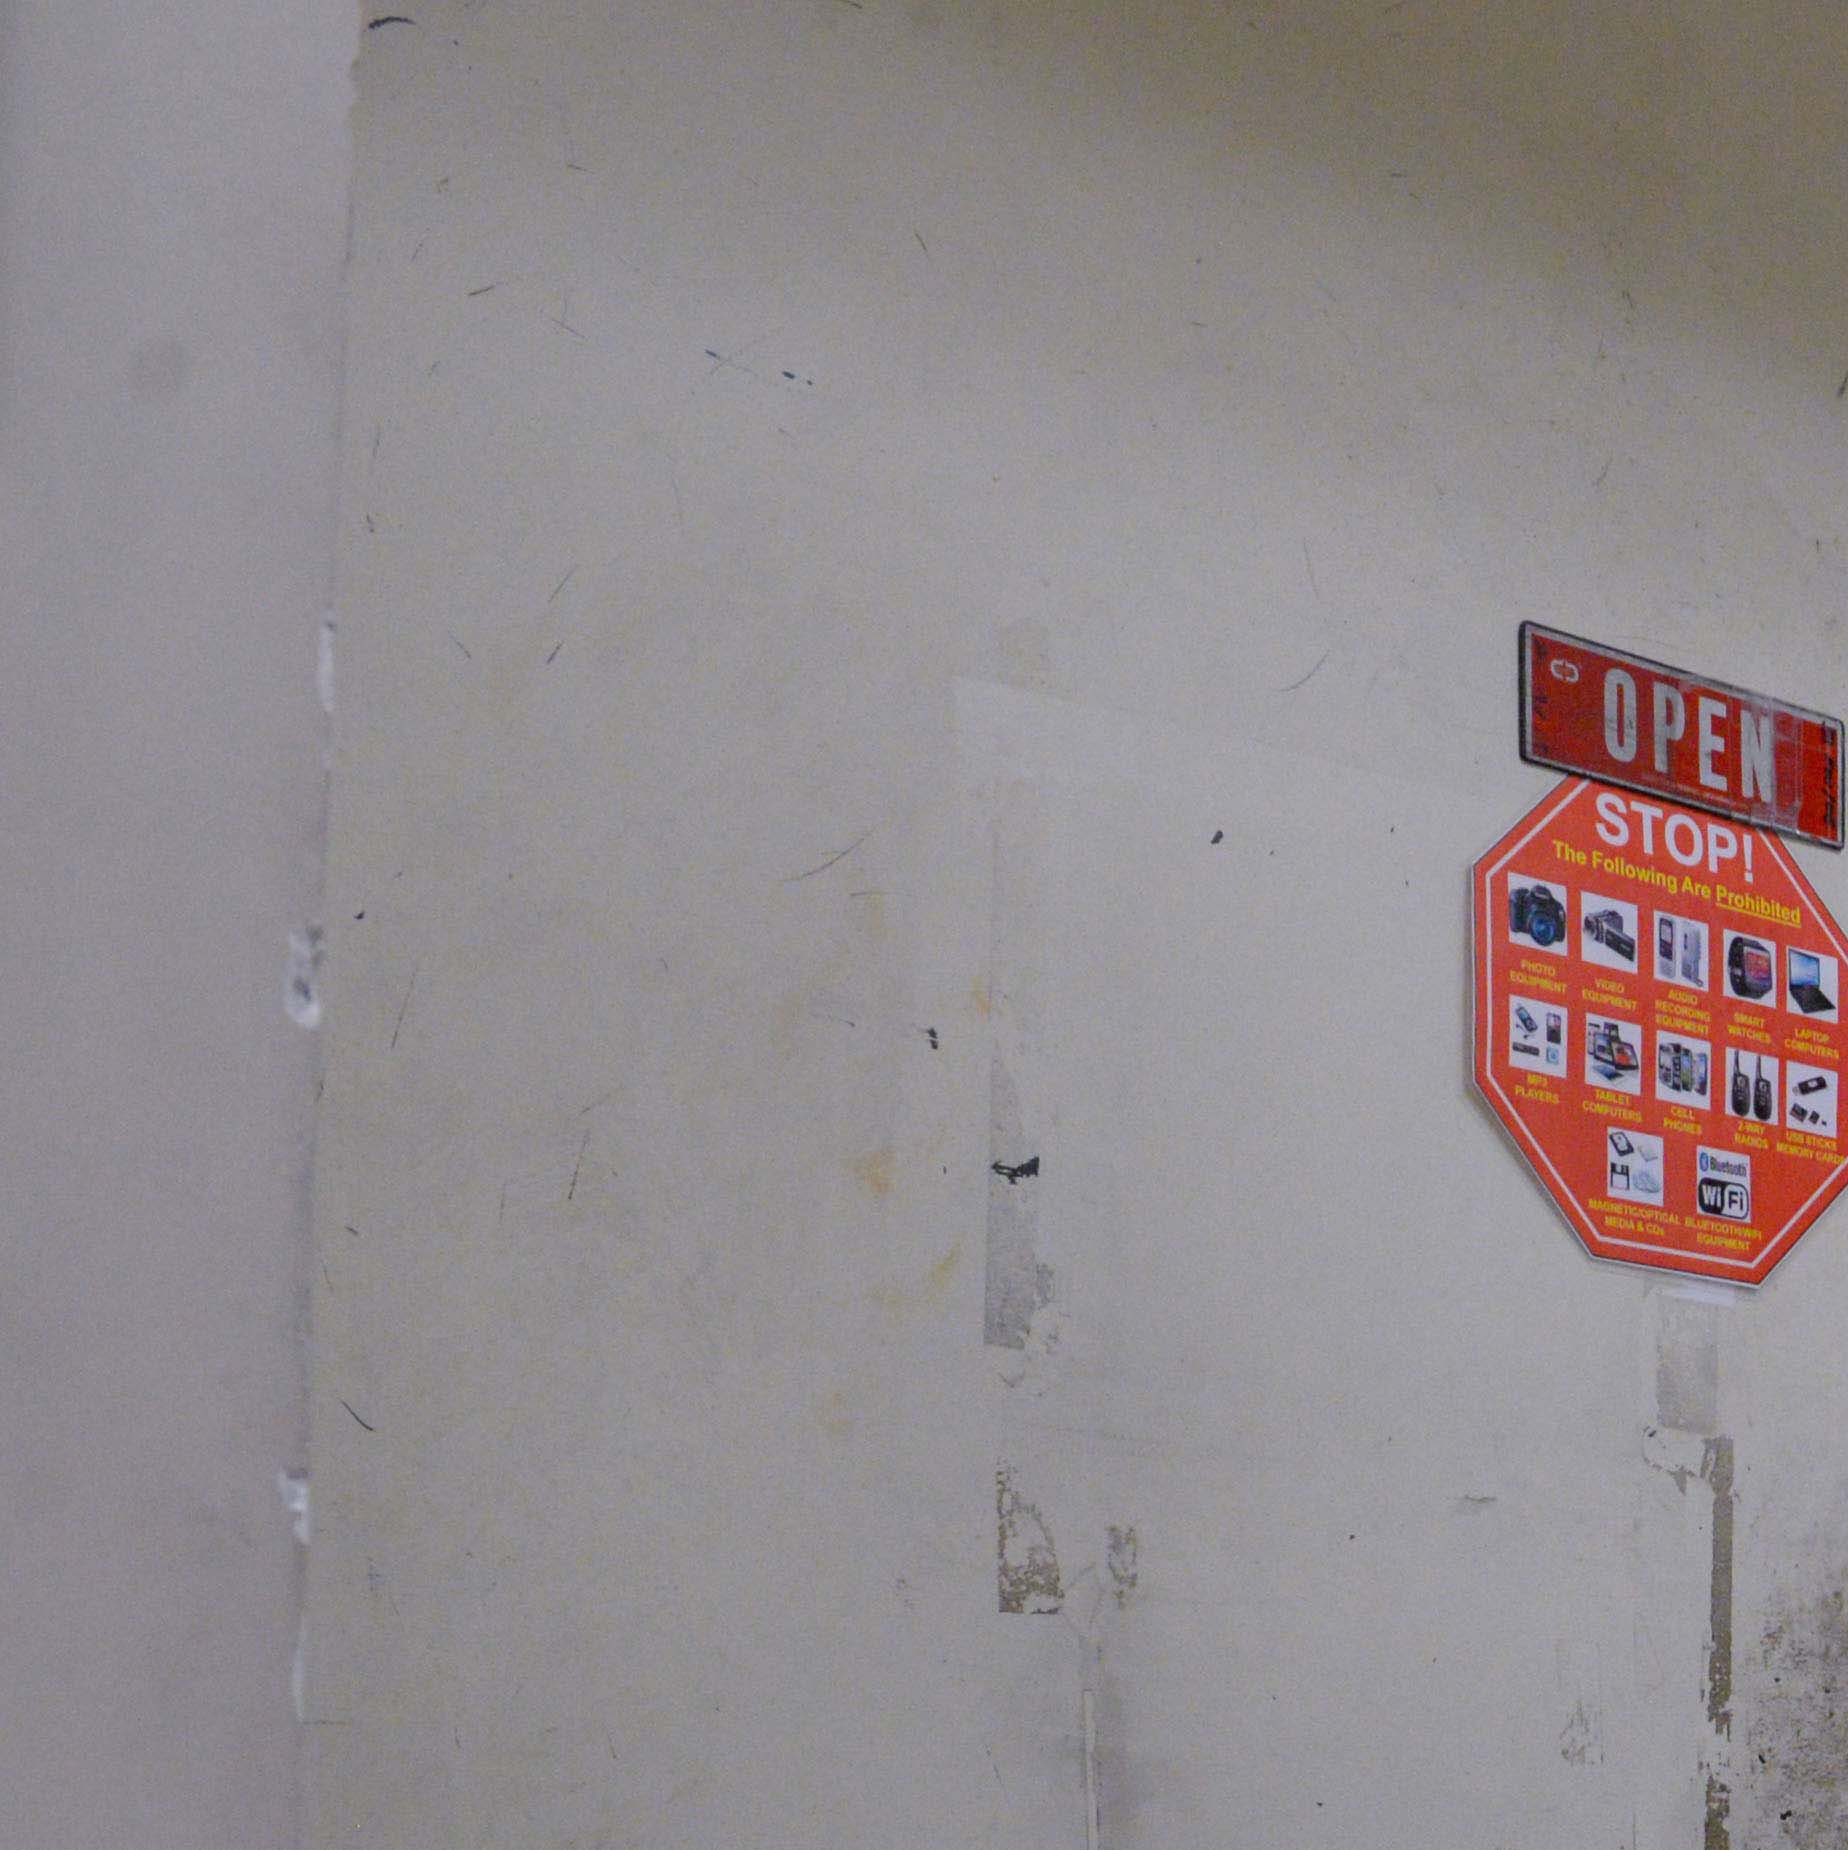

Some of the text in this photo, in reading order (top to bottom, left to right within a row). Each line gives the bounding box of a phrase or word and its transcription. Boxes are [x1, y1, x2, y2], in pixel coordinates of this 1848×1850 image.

[1603, 668, 1772, 803] OPEN
[1596, 792, 1755, 884] STOP!
[1553, 839, 1801, 928] The Following Are Prohibited
[1520, 959, 1556, 978] PHOTO
[1509, 970, 1568, 994] EQUIPMENT
[1582, 988, 1637, 1011] EQUIPMENT
[1655, 999, 1712, 1023] RECORDING
[1656, 1014, 1709, 1036] EQUIPMENT
[1795, 1028, 1830, 1043] LAPTOP
[1515, 1084, 1560, 1105] PLAYERS
[1596, 1089, 1631, 1106] TABLET
[1582, 1100, 1643, 1124] COMPUTERS
[1710, 1156, 1748, 1178] Bluetooth
[1605, 1216, 1636, 1231] MEDIA
